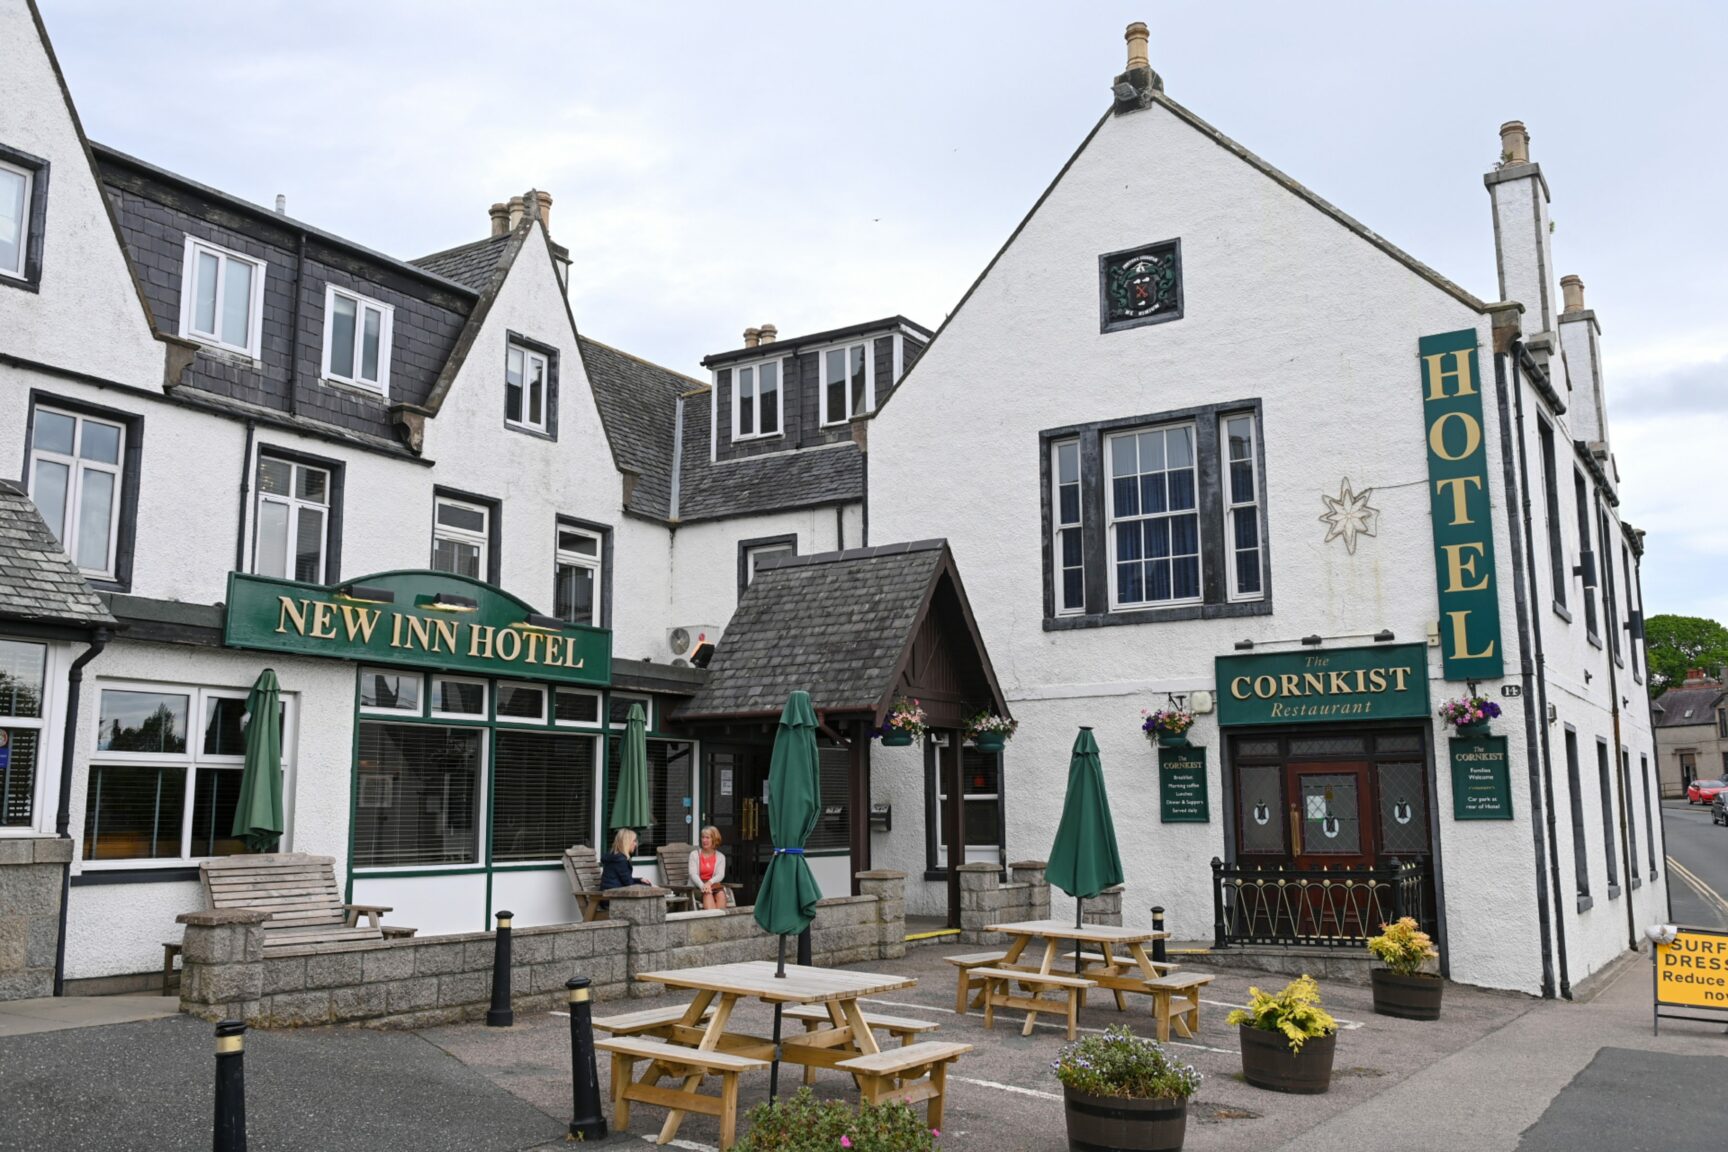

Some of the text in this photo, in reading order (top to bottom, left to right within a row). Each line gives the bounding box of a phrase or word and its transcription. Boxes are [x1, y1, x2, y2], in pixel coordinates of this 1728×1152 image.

[1422, 347, 1495, 660] HOTEL
[275, 595, 584, 669] NEW INN HOTEL
[1305, 656, 1330, 667] The
[1230, 666, 1412, 700] CORNKIST
[1271, 700, 1373, 718] Restaurant
[1163, 761, 1202, 769] CORNKIST
[1455, 753, 1504, 761] CORNKIST
[1671, 938, 1727, 954] SURF
[1663, 970, 1725, 986] Reduce
